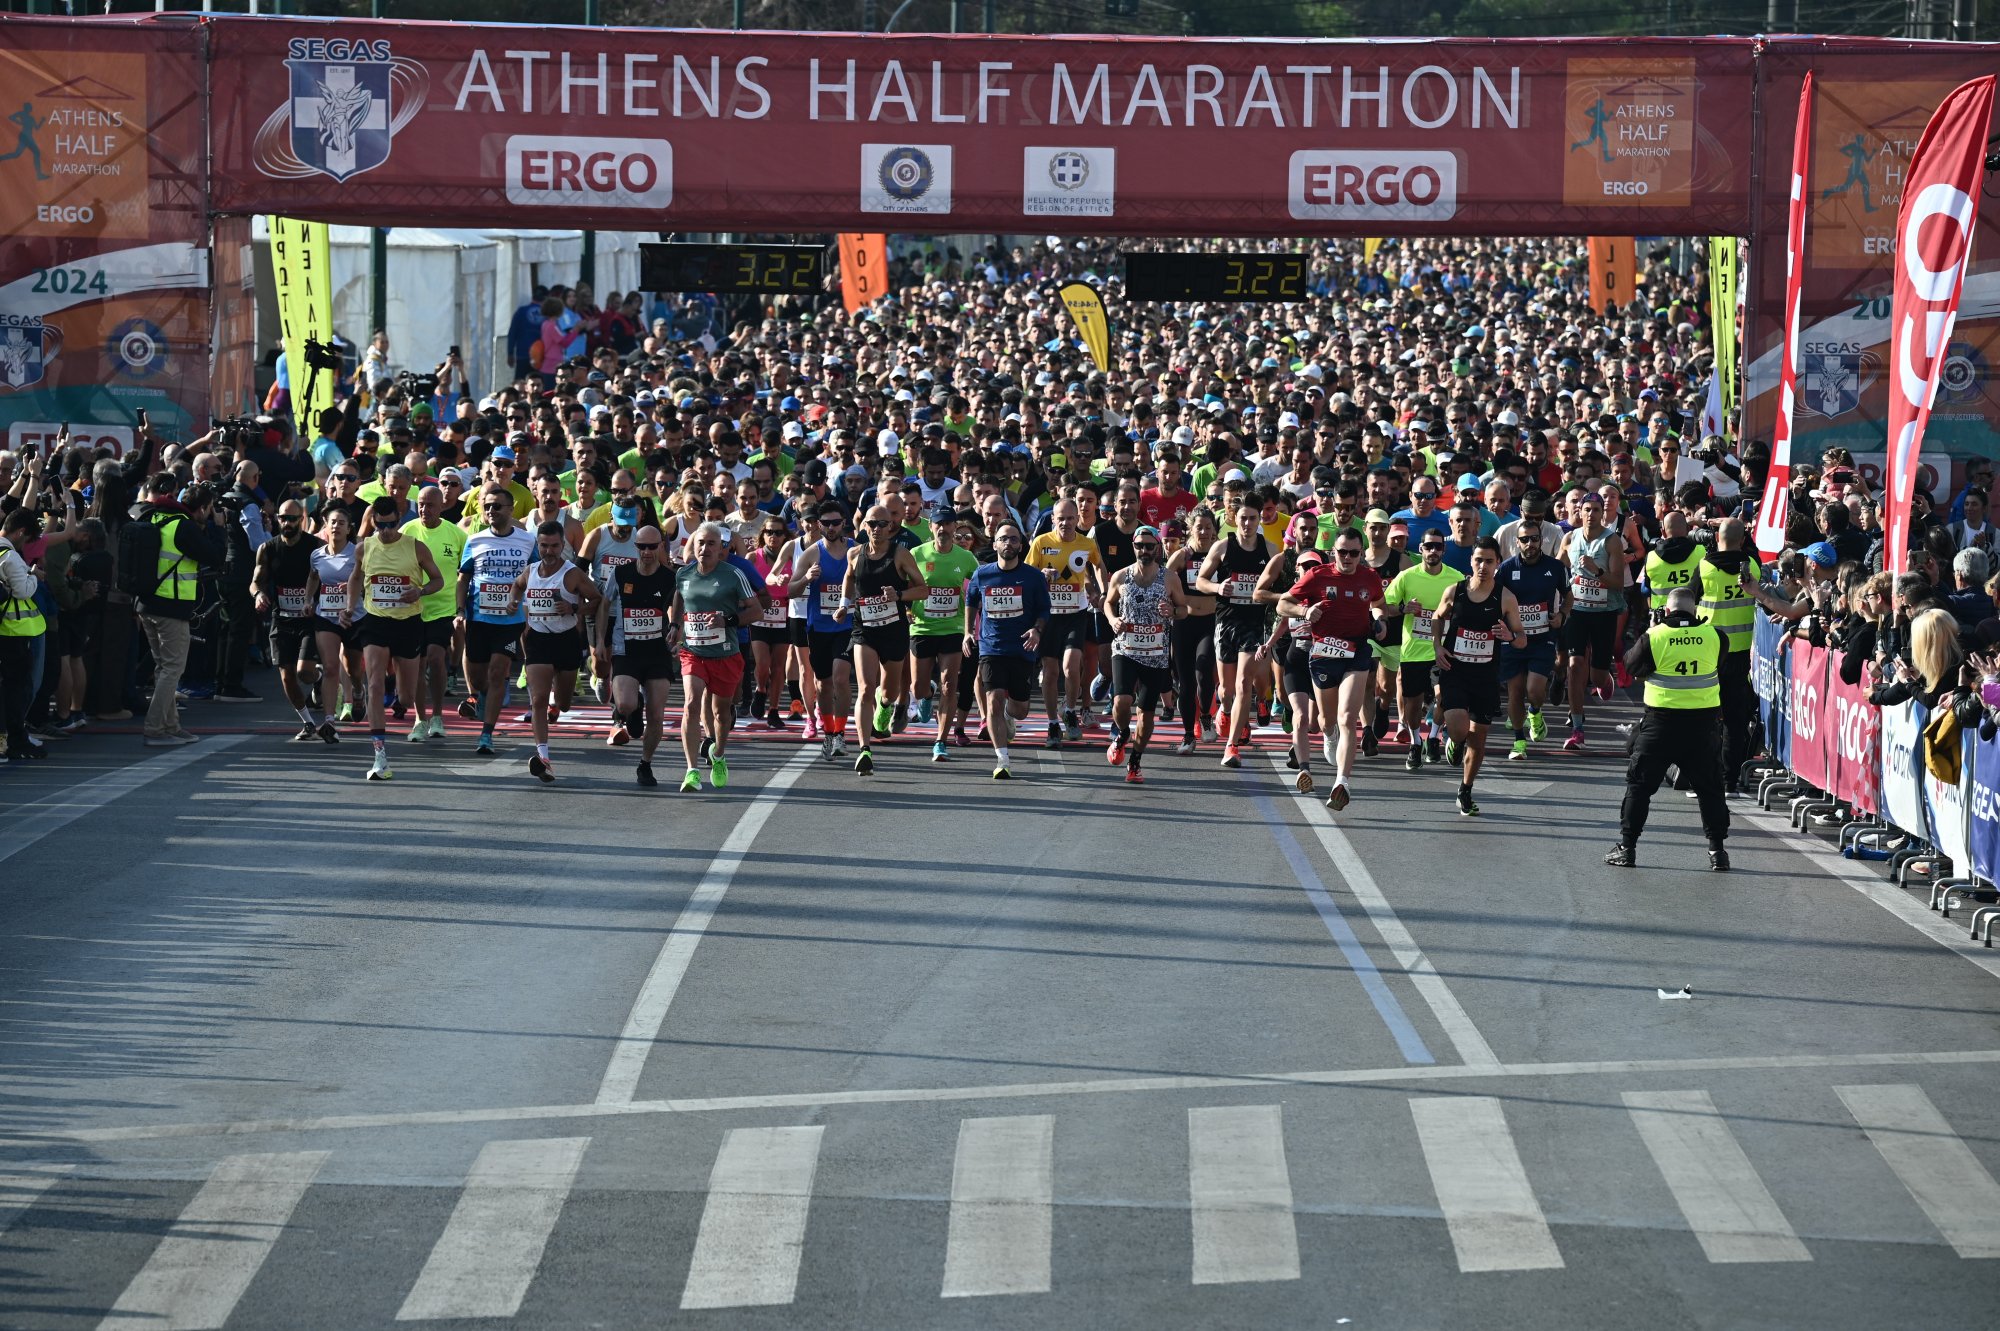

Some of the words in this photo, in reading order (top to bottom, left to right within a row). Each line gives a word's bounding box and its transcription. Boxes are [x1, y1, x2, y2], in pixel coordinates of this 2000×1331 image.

[288, 38, 391, 61] SEGAS
[455, 50, 771, 119] ATHENS
[810, 58, 1013, 123] HALF
[1050, 63, 1519, 129] MARATHON
[1616, 105, 1674, 117] ATHENS
[48, 110, 123, 127] ATHENS
[1620, 124, 1668, 140] HALF
[55, 135, 115, 155] HALF
[1617, 148, 1670, 156] MARATHON
[52, 163, 120, 175] MARATHON
[522, 150, 658, 193] ERGO
[1304, 165, 1441, 206] ERGO
[1603, 181, 1648, 195] ERGO
[37, 205, 93, 223] ERGO
[32, 268, 108, 295] 2024
[1805, 343, 1860, 353] SEGAS
[486, 548, 507, 556] run
[510, 548, 522, 556] to
[482, 557, 525, 569] change
[378, 576, 402, 584] ERGO
[1668, 570, 1689, 584] 45
[1580, 577, 1601, 587] ERGO
[283, 586, 306, 596] ERGO
[380, 586, 402, 594] 4284
[486, 584, 509, 593] ERGO
[931, 588, 954, 596] ERGO
[991, 587, 1014, 595] ERGO
[1580, 587, 1600, 595] 5116
[1724, 585, 1744, 600] 52
[487, 593, 507, 602] 3591
[530, 589, 552, 598] ERGO
[1051, 593, 1072, 601] 3183
[326, 595, 344, 603] 4001
[531, 599, 552, 607] 4420
[864, 596, 889, 605] ERGO
[932, 597, 953, 605] 3420
[993, 597, 1013, 605] 5411
[630, 609, 655, 617] ERGO
[867, 604, 889, 614] 3353
[1518, 604, 1541, 613] ERGO
[1520, 613, 1541, 622] 5008
[632, 618, 654, 627] 3993
[1132, 625, 1157, 634] ERGO
[1134, 634, 1155, 643] 3210
[1463, 630, 1488, 640] ERGO
[1323, 636, 1349, 649] ERGO
[1463, 640, 1486, 649] 1116
[1669, 637, 1703, 646] PHOTO
[1322, 645, 1346, 657] 4176
[1675, 660, 1698, 675] 41
